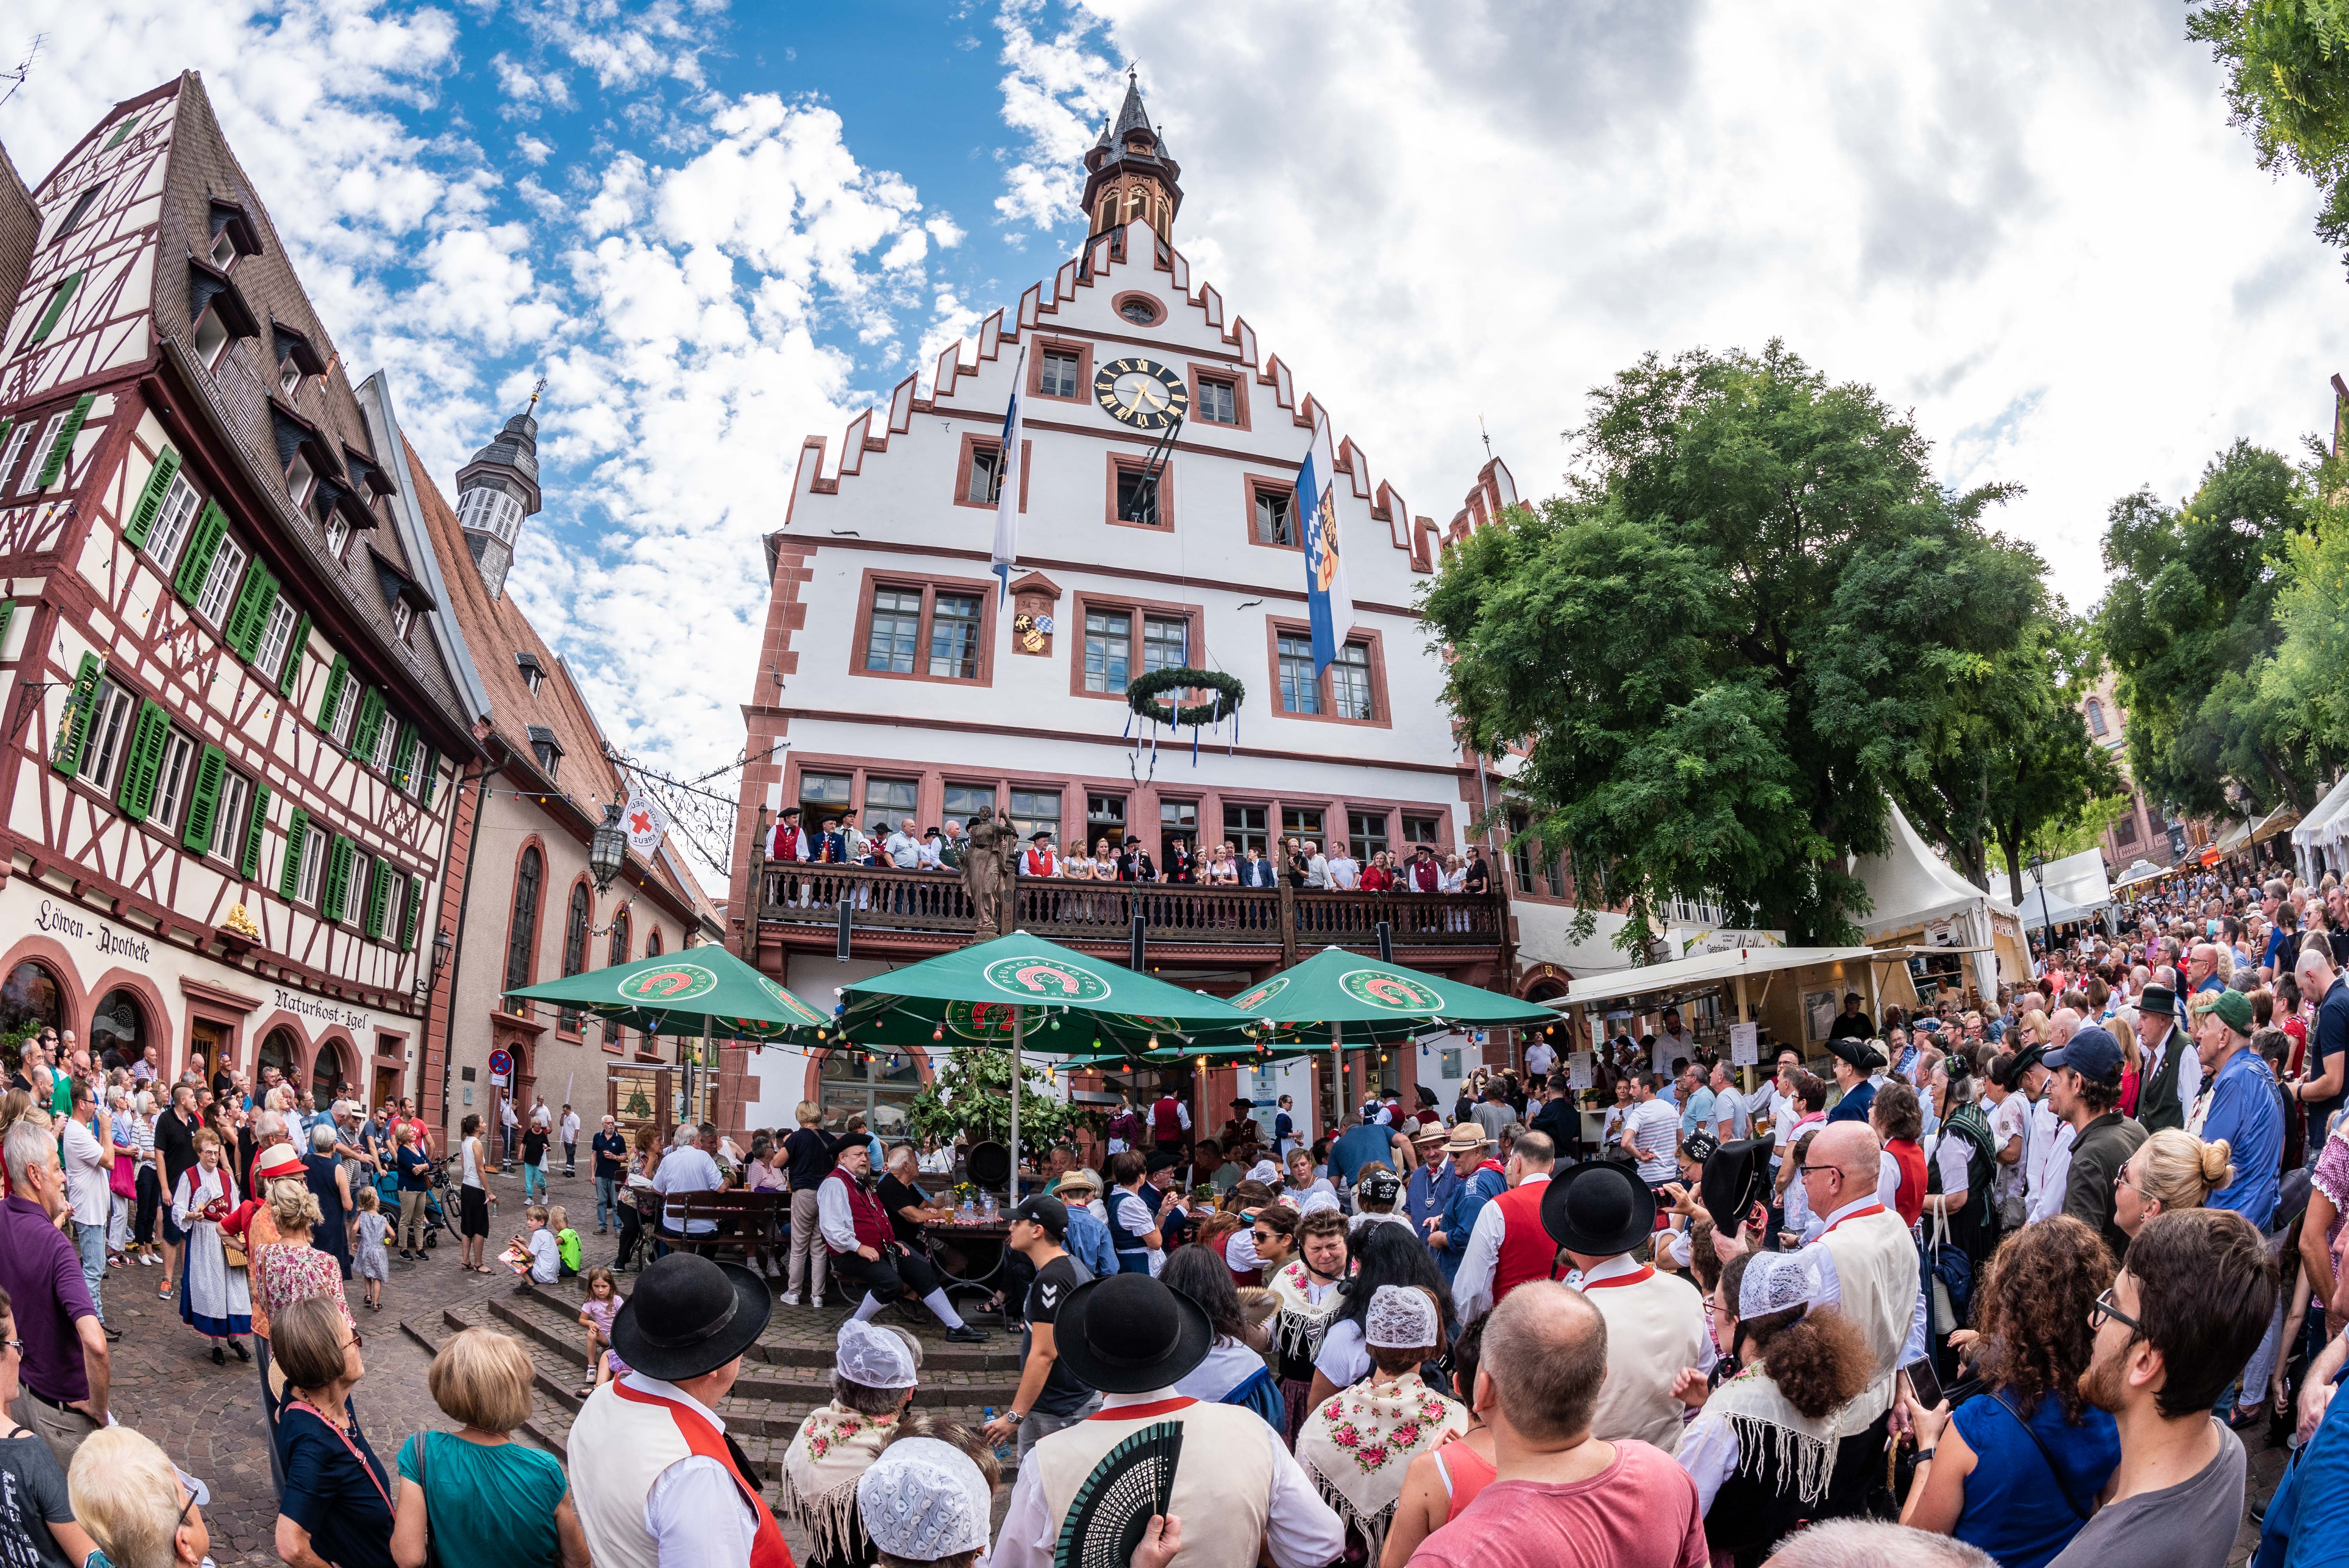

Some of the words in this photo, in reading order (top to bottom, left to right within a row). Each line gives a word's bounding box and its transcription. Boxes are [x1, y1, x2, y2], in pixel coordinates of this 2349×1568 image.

[35, 900, 83, 939] Löwen
[96, 923, 150, 963] Apotheke
[630, 967, 706, 992] PFUNGSTÄDTER
[998, 960, 1096, 990] PFUNGSTÄDTER
[1351, 974, 1431, 999] PFUNGSTÄDTER
